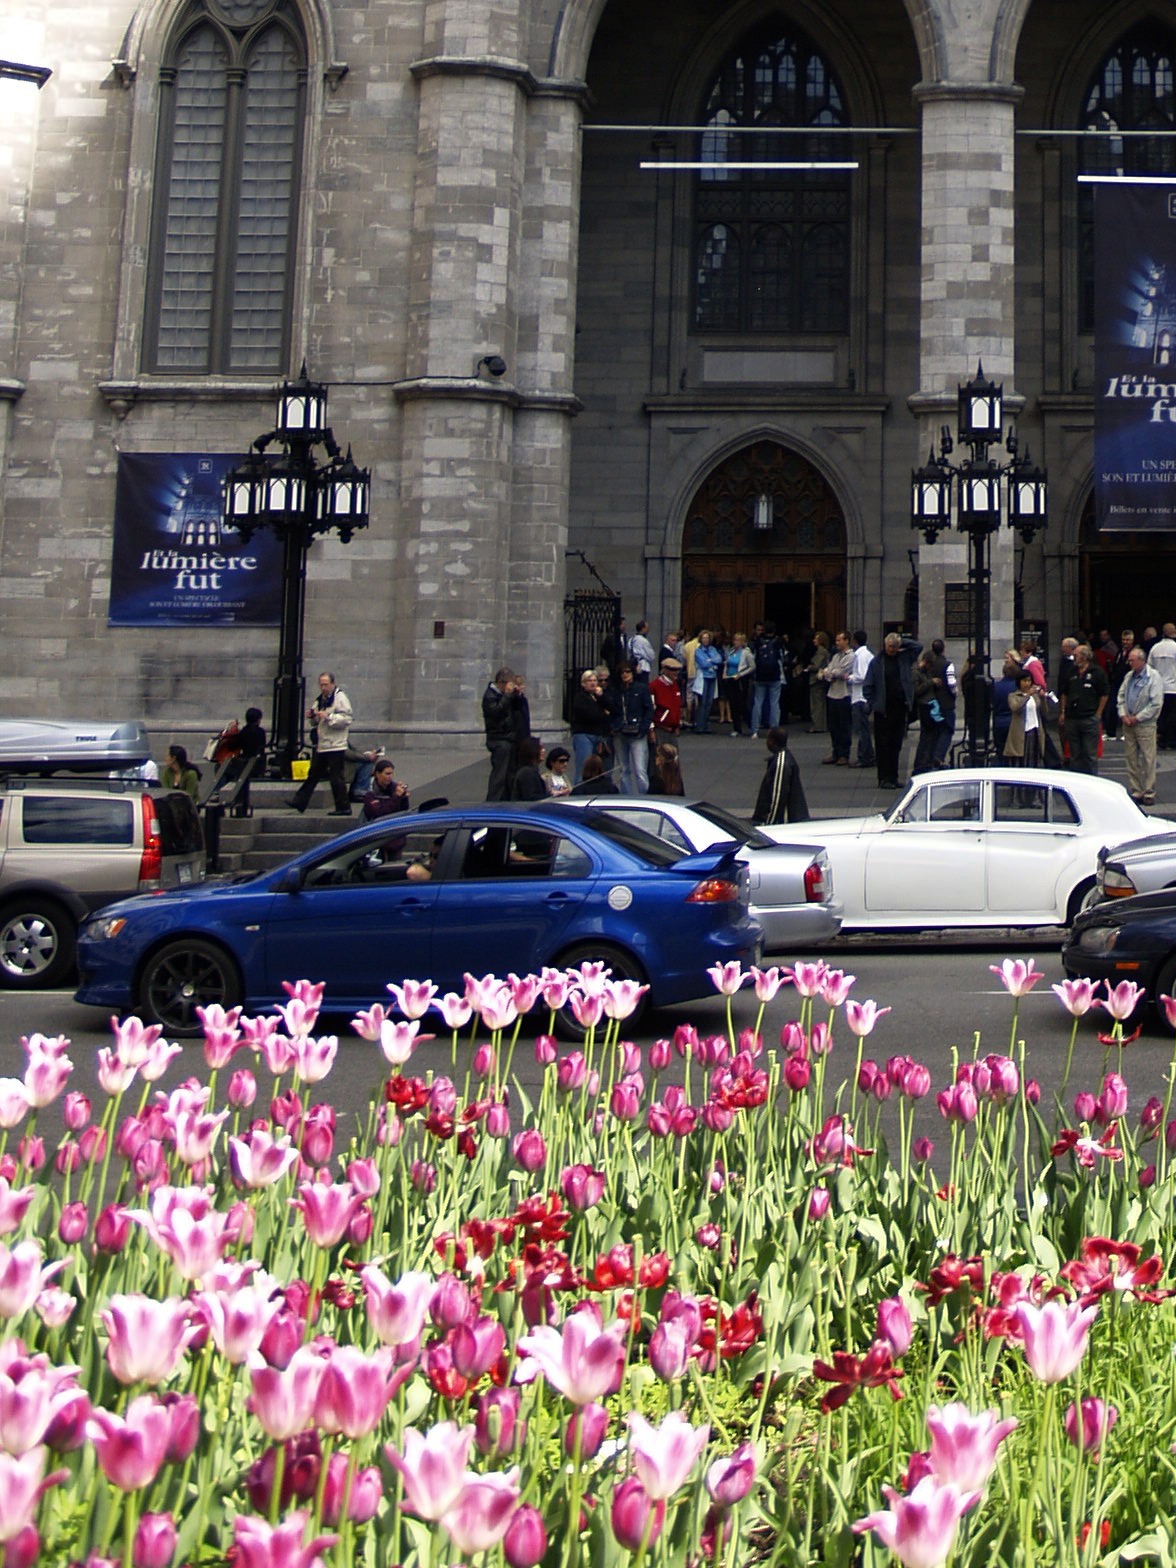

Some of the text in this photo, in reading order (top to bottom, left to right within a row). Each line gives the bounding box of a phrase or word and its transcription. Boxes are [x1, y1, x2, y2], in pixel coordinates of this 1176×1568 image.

[1142, 459, 1158, 470] UN
[1101, 472, 1124, 483] SON
[1125, 472, 1140, 483] ET
[139, 551, 258, 570] lumière
[173, 569, 223, 590] fut
